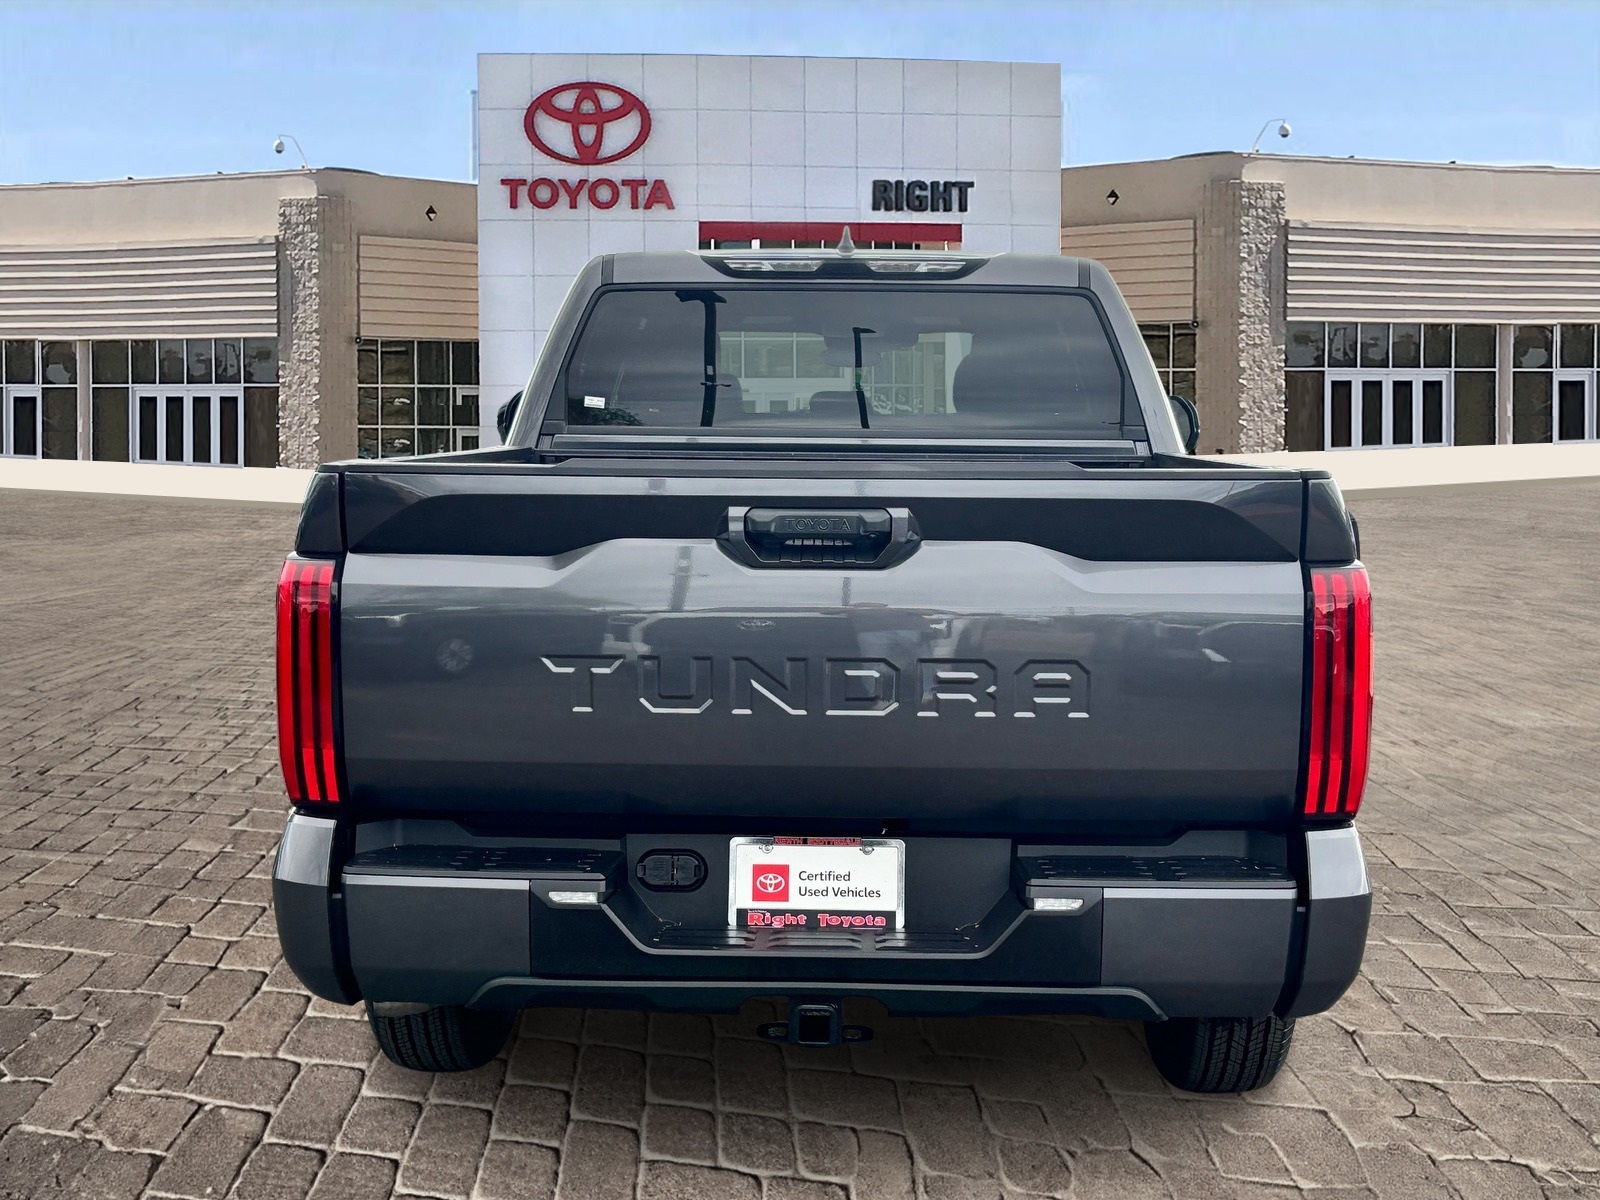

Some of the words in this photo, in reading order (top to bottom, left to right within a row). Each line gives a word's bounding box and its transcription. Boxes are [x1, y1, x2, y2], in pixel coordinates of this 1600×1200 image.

[500, 178, 675, 211] TOYOTA
[871, 179, 975, 213] RIGHT
[785, 518, 851, 532] TOYOTA
[540, 654, 1092, 719] TUNDRA
[798, 870, 851, 882] Certified
[798, 886, 829, 898] Used
[832, 886, 881, 898] Vehicles
[747, 911, 808, 927] Right
[817, 913, 886, 927] Toyota
